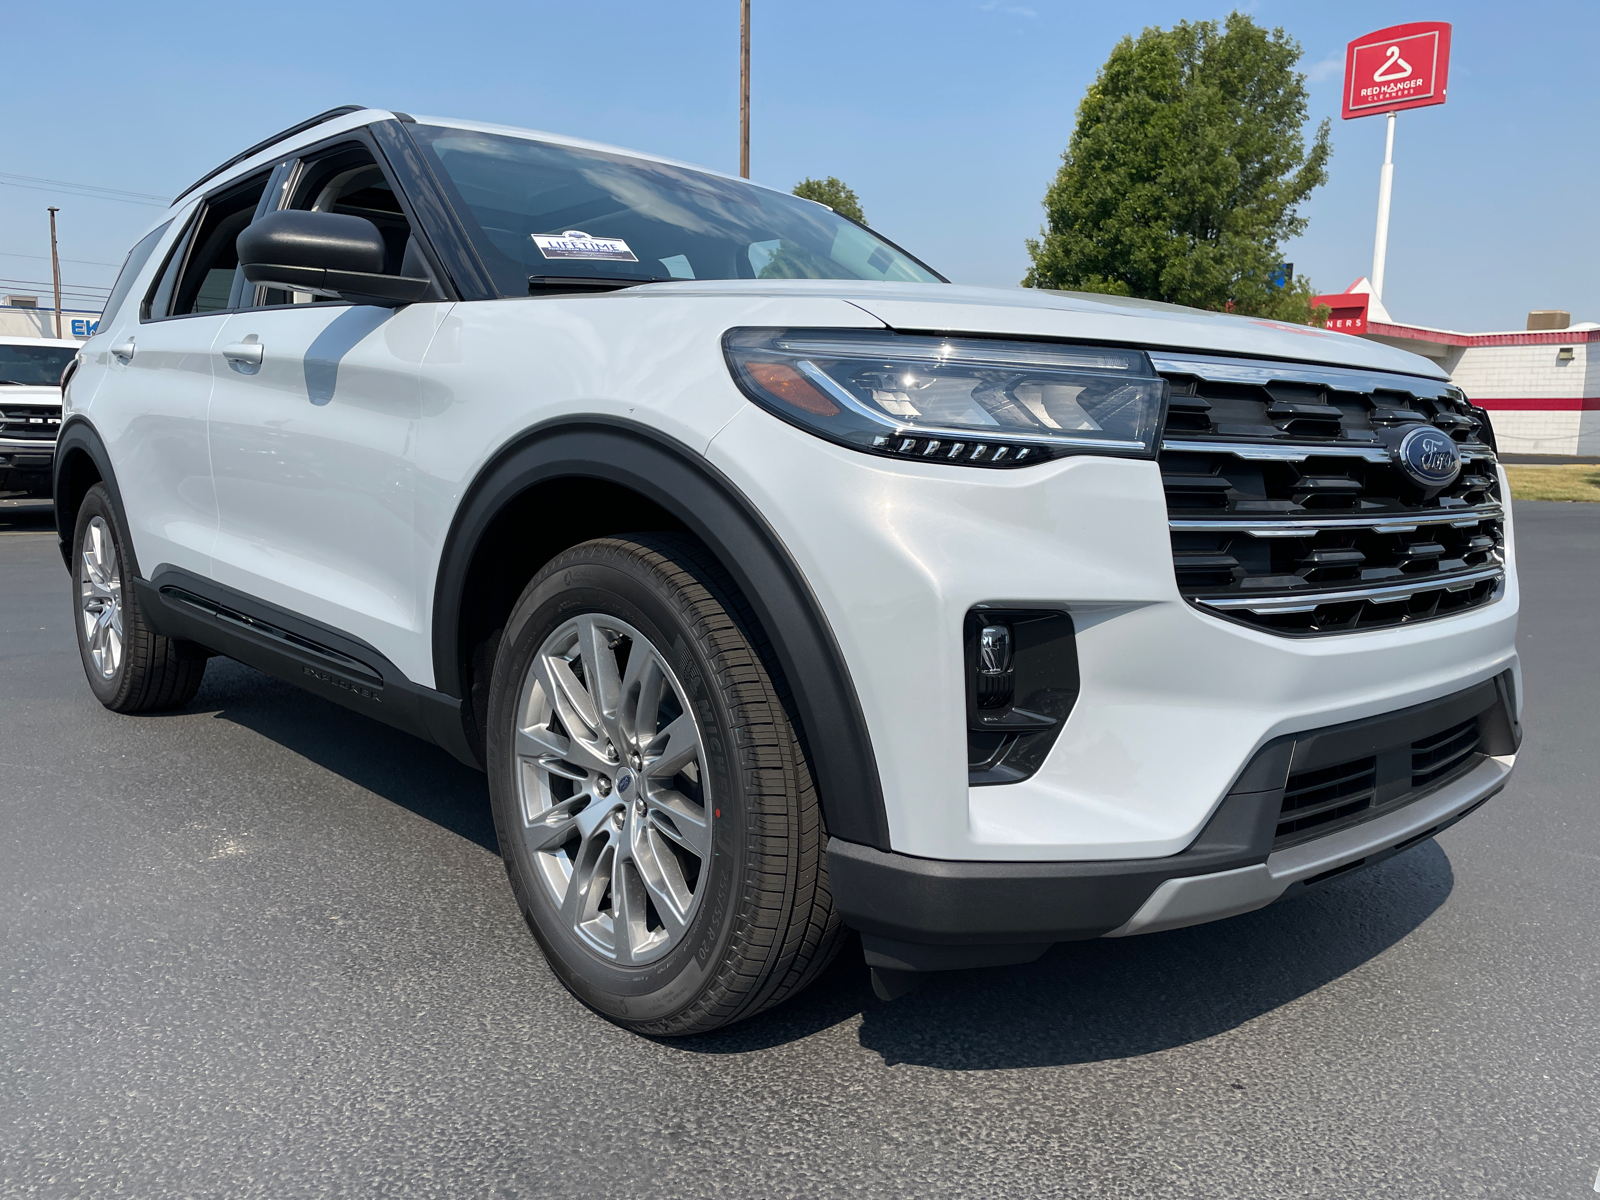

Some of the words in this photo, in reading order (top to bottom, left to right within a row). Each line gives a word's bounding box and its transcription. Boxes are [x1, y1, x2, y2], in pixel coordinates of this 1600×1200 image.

[1361, 86, 1380, 97] RED
[1381, 78, 1423, 93] HANGER
[1368, 89, 1414, 101] CLEANERS
[548, 241, 618, 251] LIFETIME
[1422, 438, 1454, 471] Ford
[302, 666, 382, 703] EXPLORER
[698, 700, 731, 845] MICHELIN
[711, 869, 729, 927] 255/55
[706, 926, 716, 941] R
[698, 939, 710, 960] 20
